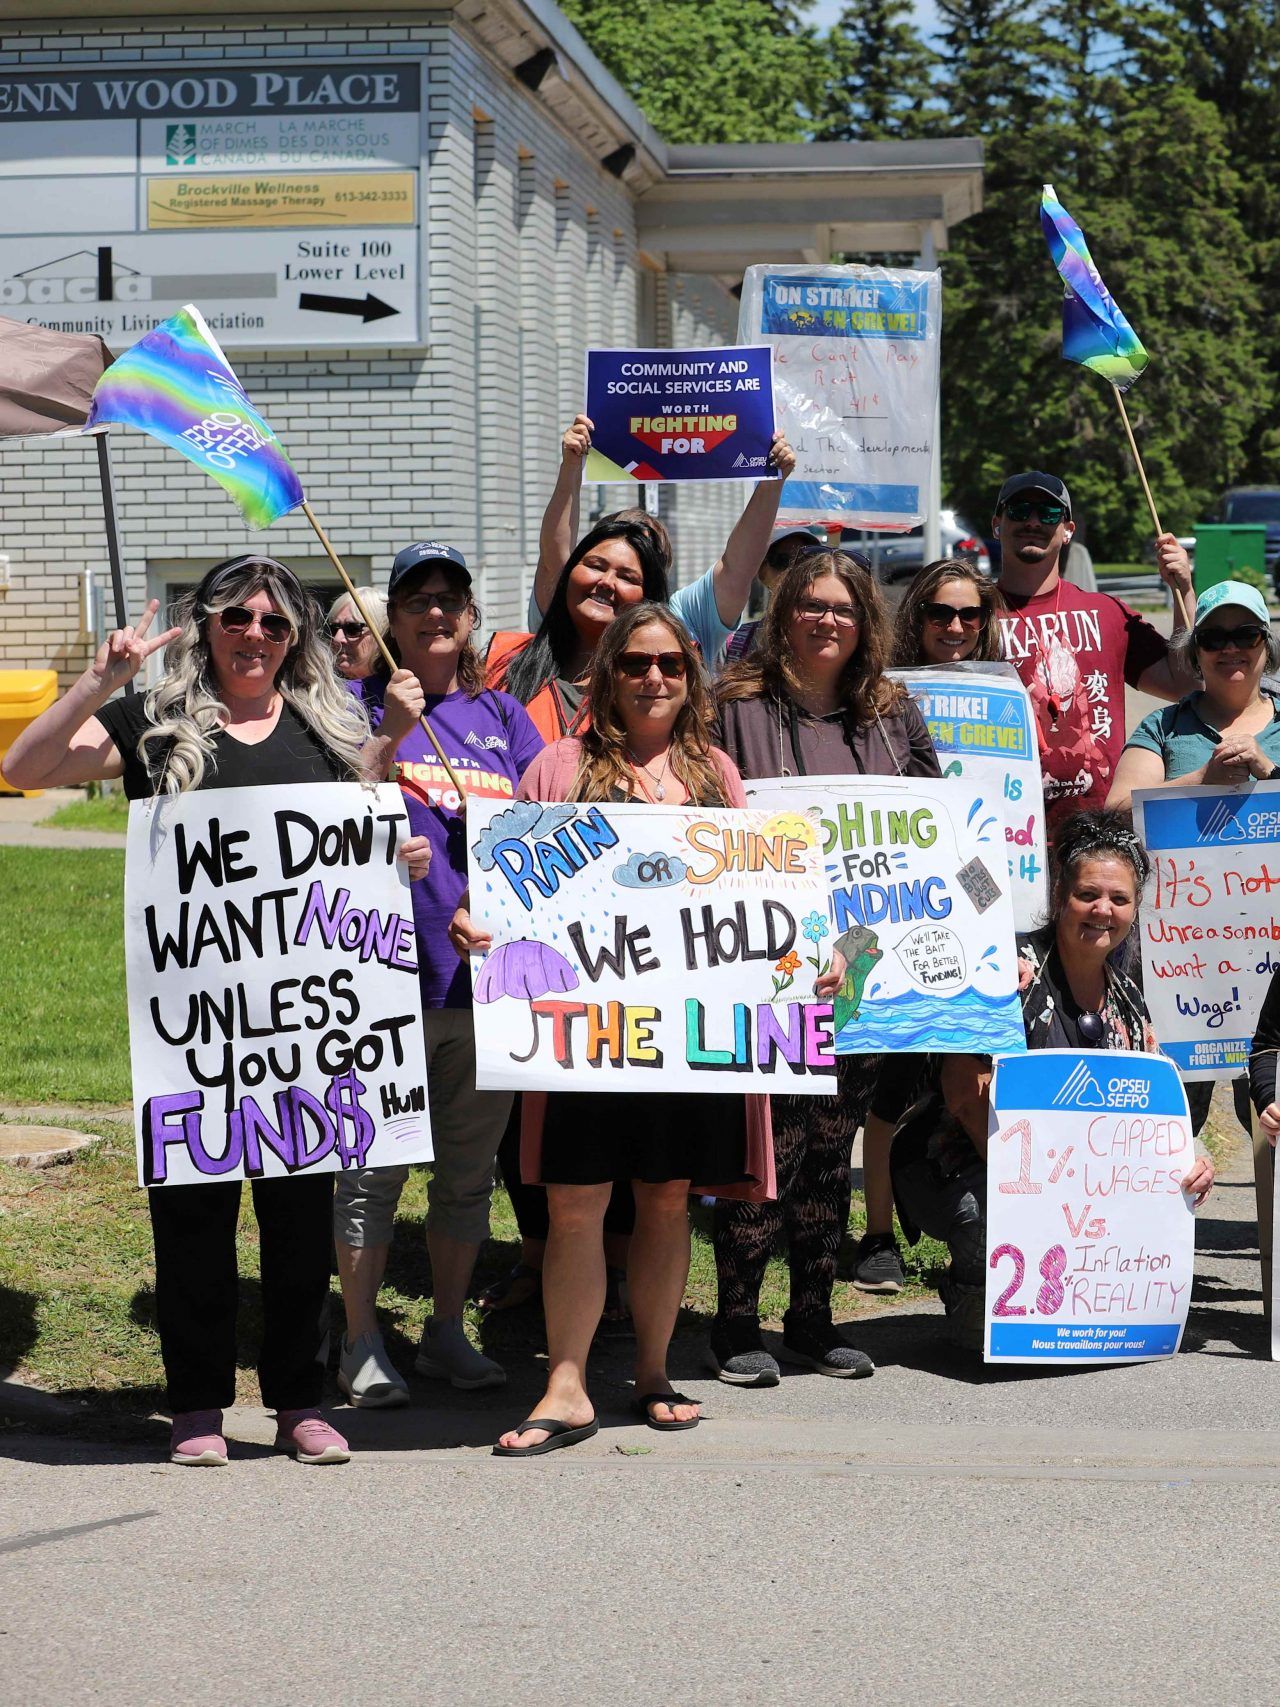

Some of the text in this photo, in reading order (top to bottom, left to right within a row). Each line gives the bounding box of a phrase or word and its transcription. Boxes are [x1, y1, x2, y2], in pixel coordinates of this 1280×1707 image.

[94, 77, 237, 111] WOOD
[251, 72, 400, 107] PLACE
[201, 121, 257, 135] MARCH
[278, 118, 366, 133] LA MARCHE
[201, 135, 269, 151] OF DIMES
[278, 132, 390, 149] DES DIX SOUS
[201, 151, 268, 166] CANADA
[278, 148, 377, 164] DU CANADA
[177, 181, 320, 197] Brockville Wellness
[170, 190, 408, 209] Registered Massage Therapy 613-342-3333
[297, 240, 392, 258] Suite 100
[284, 263, 406, 282] Lower Level
[776, 286, 880, 309] ON STRIKE!
[621, 361, 748, 376] COMMUNITY AND
[607, 378, 761, 395] SOCIAL SERVICES ARE
[661, 404, 710, 414] WORTH
[630, 415, 737, 434] FIGHTING
[661, 437, 706, 455] FOR
[999, 609, 1102, 660] KARUN
[930, 718, 1025, 751] EN GRÈVE!
[174, 807, 407, 895] WE DON'T
[491, 806, 808, 912] RAIN OR SHINE
[843, 851, 892, 882] FOR
[1154, 856, 1212, 909] It's
[145, 880, 419, 975] WANT NONE
[931, 930, 951, 943] TAKE
[566, 899, 798, 983] WE HOLD
[903, 943, 946, 958] THE BAIT
[912, 955, 960, 972] FOR BETTER
[1218, 960, 1241, 974] a
[920, 966, 963, 984] FUNDING!
[149, 968, 362, 1046] UNLESS
[529, 998, 838, 1076] THE LINE
[1193, 1041, 1250, 1055] ORGANIZE.
[185, 1014, 416, 1114] YOU GOT
[1189, 1052, 1224, 1066] FIGHT.
[1108, 1077, 1151, 1093] OPSEU
[1106, 1090, 1149, 1108] SEFPO
[143, 1067, 377, 1186] FUND$
[1087, 1115, 1188, 1158] CAPPED
[1084, 1163, 1183, 1198] WAGES
[1072, 1244, 1171, 1273] Inflation
[1072, 1278, 1187, 1316] REALITY
[1057, 1327, 1127, 1341] We work for you!
[1032, 1339, 1146, 1352] Nous travaillons pour vous!
